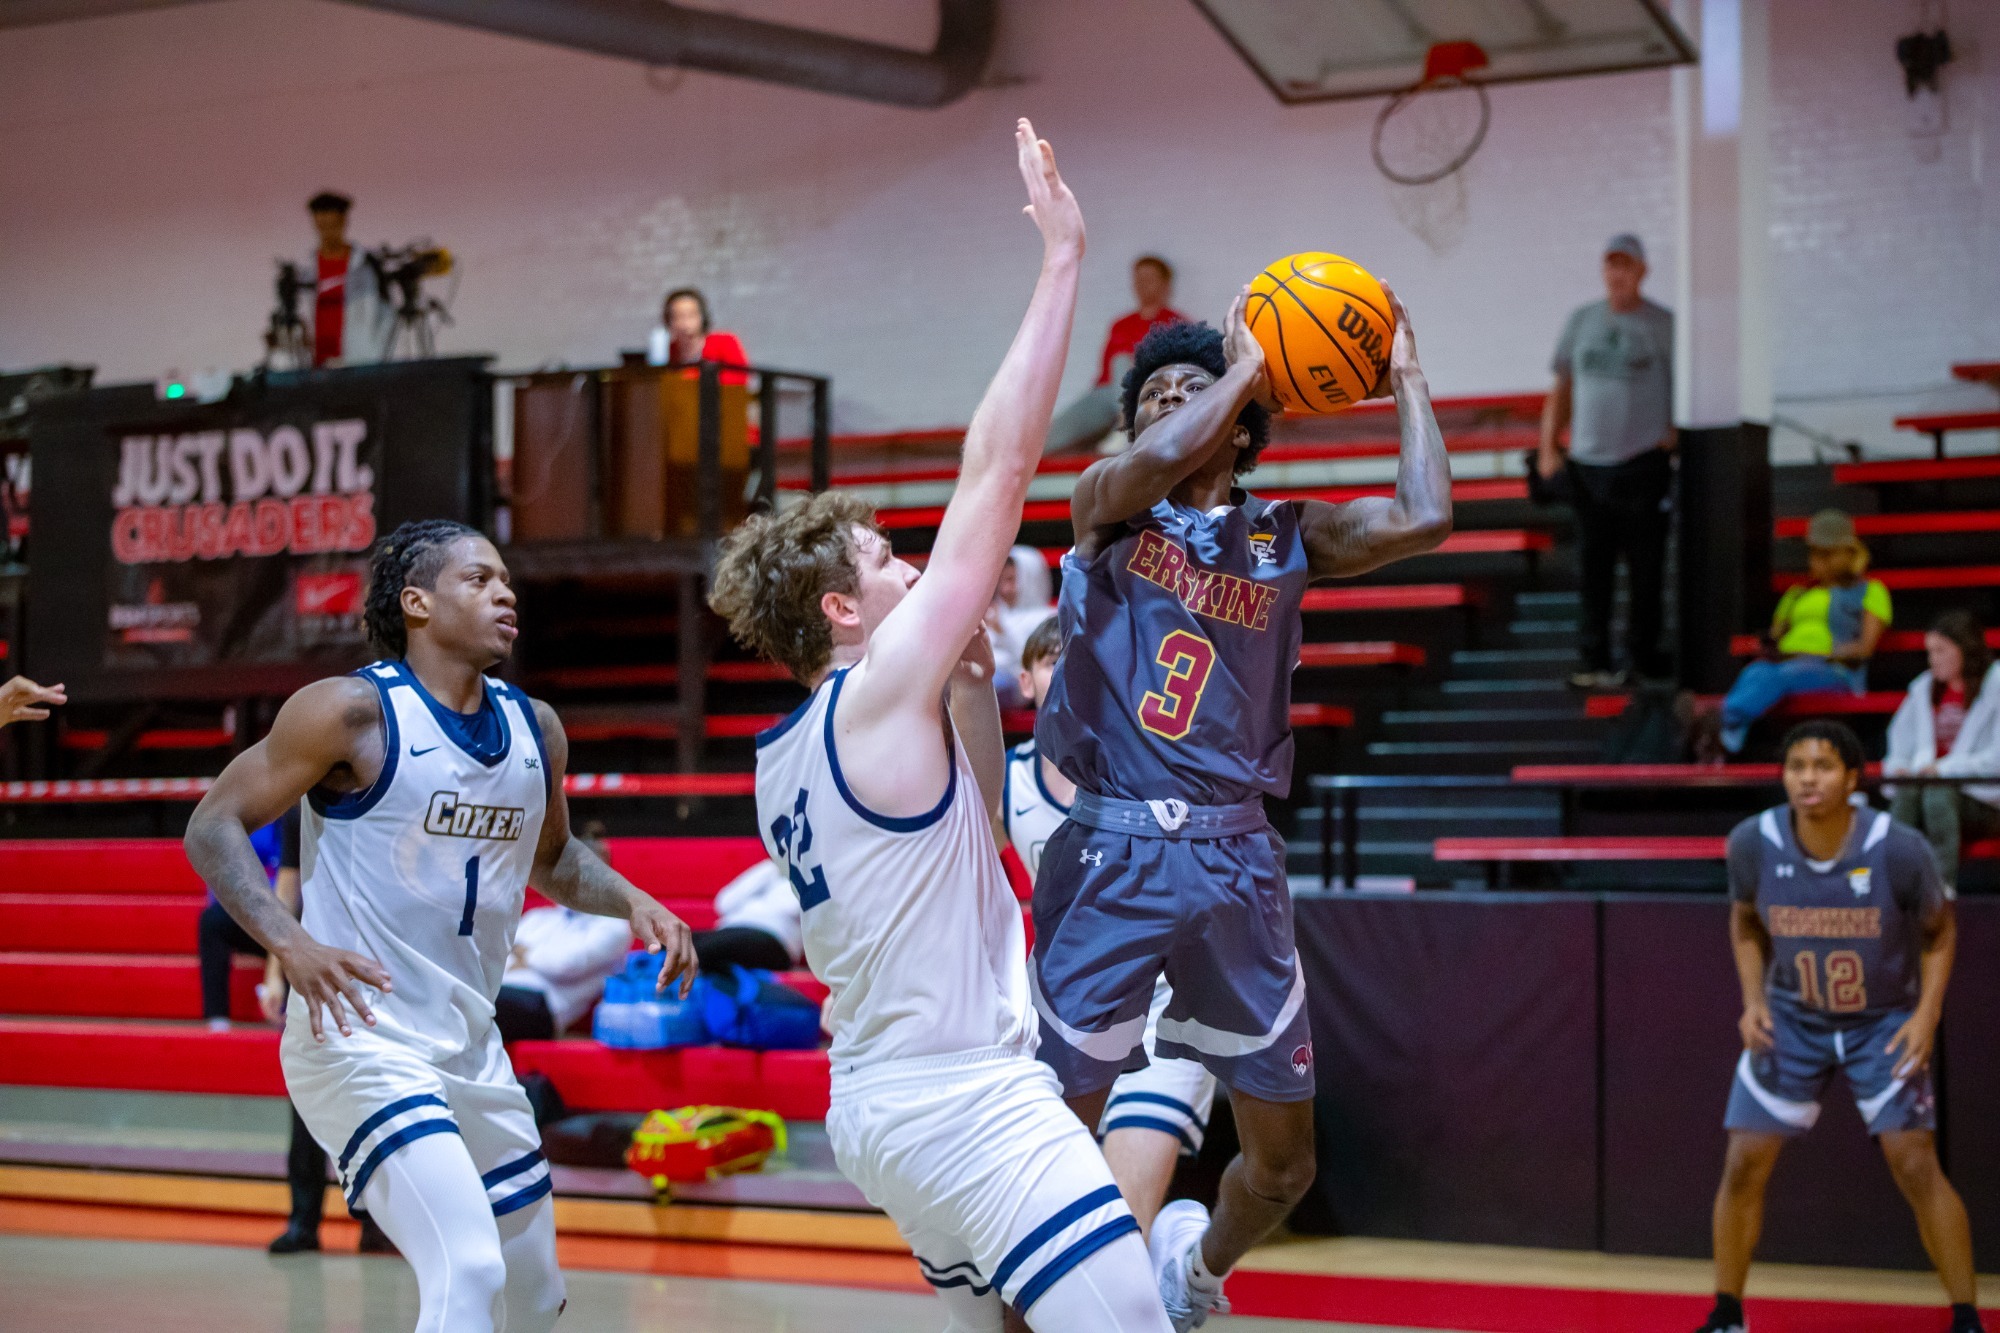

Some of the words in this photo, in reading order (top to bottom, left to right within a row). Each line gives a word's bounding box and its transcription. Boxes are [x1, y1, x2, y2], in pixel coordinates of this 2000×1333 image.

[113, 433, 227, 507] JUST
[229, 427, 311, 499] DO
[313, 420, 374, 492] IT.
[112, 495, 375, 562] CRUSADERS
[1127, 529, 1280, 631] ERSKINE
[1137, 629, 1216, 741] 3
[524, 758, 540, 770] SAC
[770, 787, 831, 912] 22
[458, 856, 480, 936] 1
[1794, 950, 1867, 1013] 12
